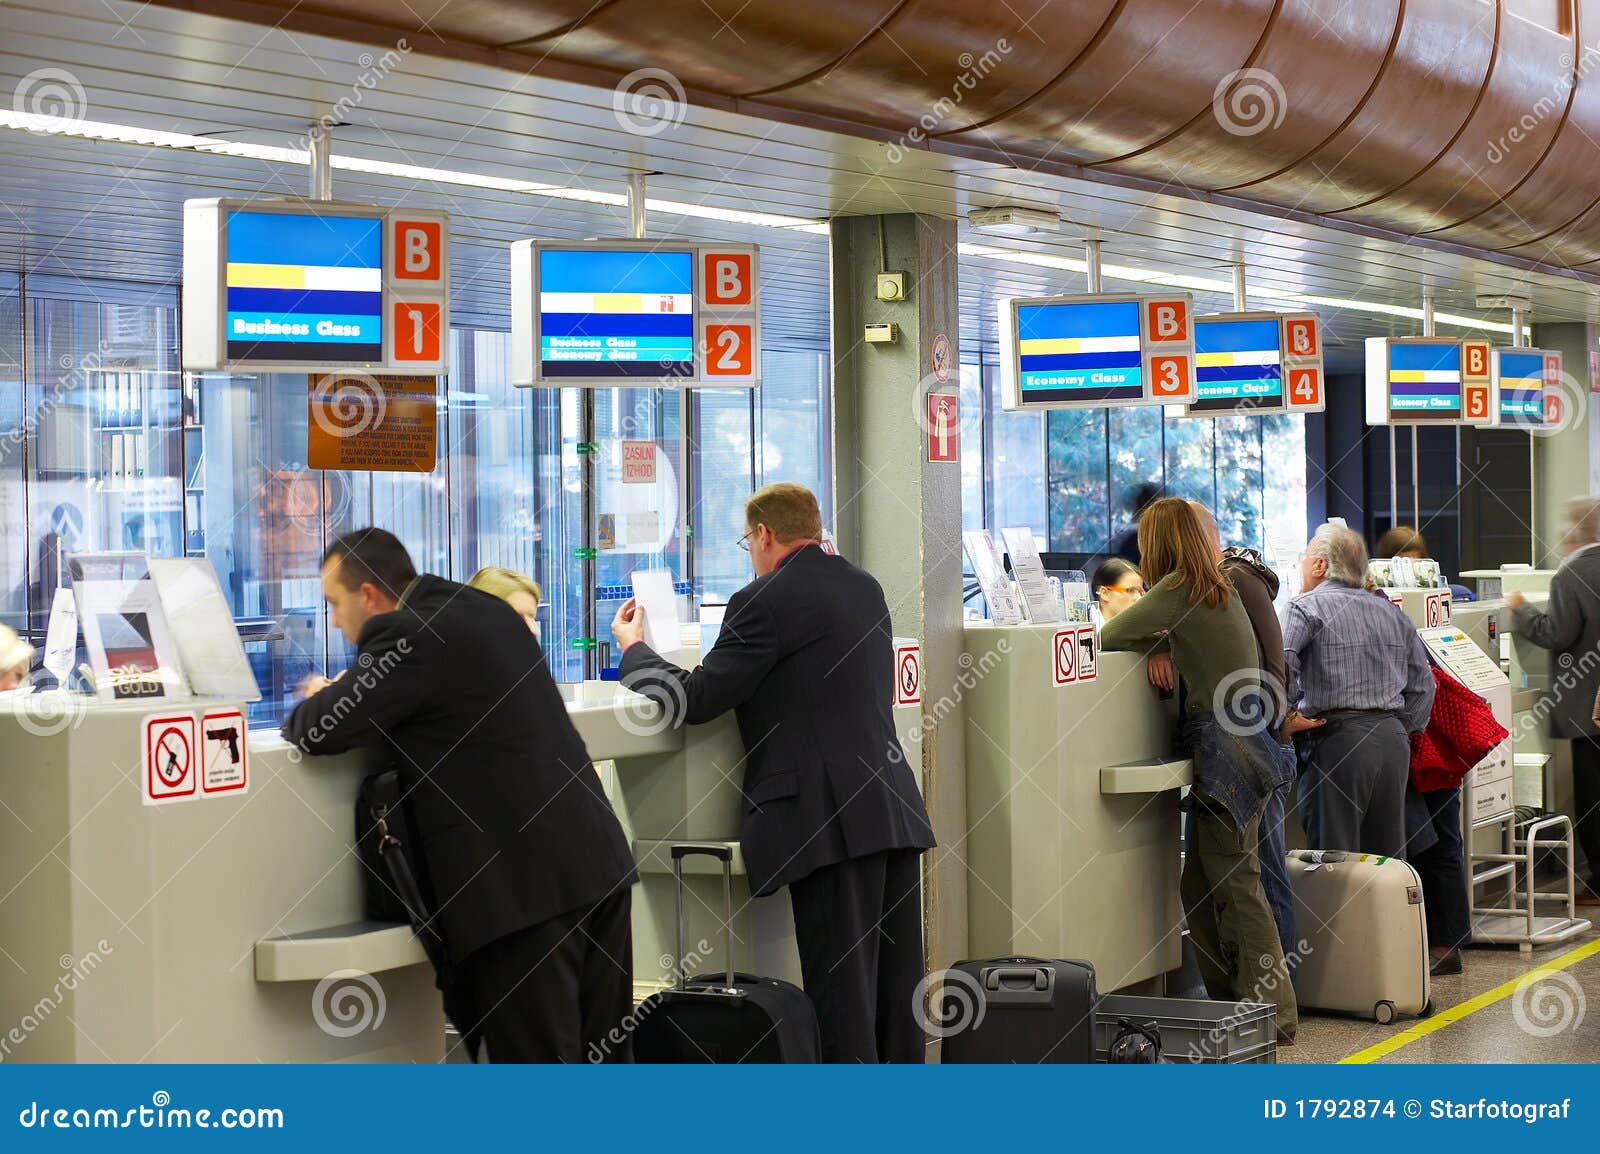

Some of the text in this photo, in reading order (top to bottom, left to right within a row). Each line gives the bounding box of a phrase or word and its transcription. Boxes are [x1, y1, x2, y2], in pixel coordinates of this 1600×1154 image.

[404, 228, 430, 273] B
[716, 259, 742, 298] B
[233, 318, 361, 337] Business Class
[407, 310, 423, 354] 1
[1156, 306, 1178, 337] B
[550, 337, 637, 348] Business Class
[716, 330, 741, 369] 2
[1293, 324, 1310, 352] B
[550, 350, 603, 361] Economy
[1470, 349, 1483, 373] B
[1026, 373, 1126, 387] Economy Class
[1159, 360, 1180, 392] 3
[1295, 373, 1314, 401] 4
[1197, 383, 1270, 395] conomy Class
[1392, 398, 1427, 408] Economy
[1471, 391, 1483, 415] 5
[625, 447, 654, 460] ZASILNI
[626, 463, 653, 477] IZHOD
[119, 682, 159, 694] GOLD
